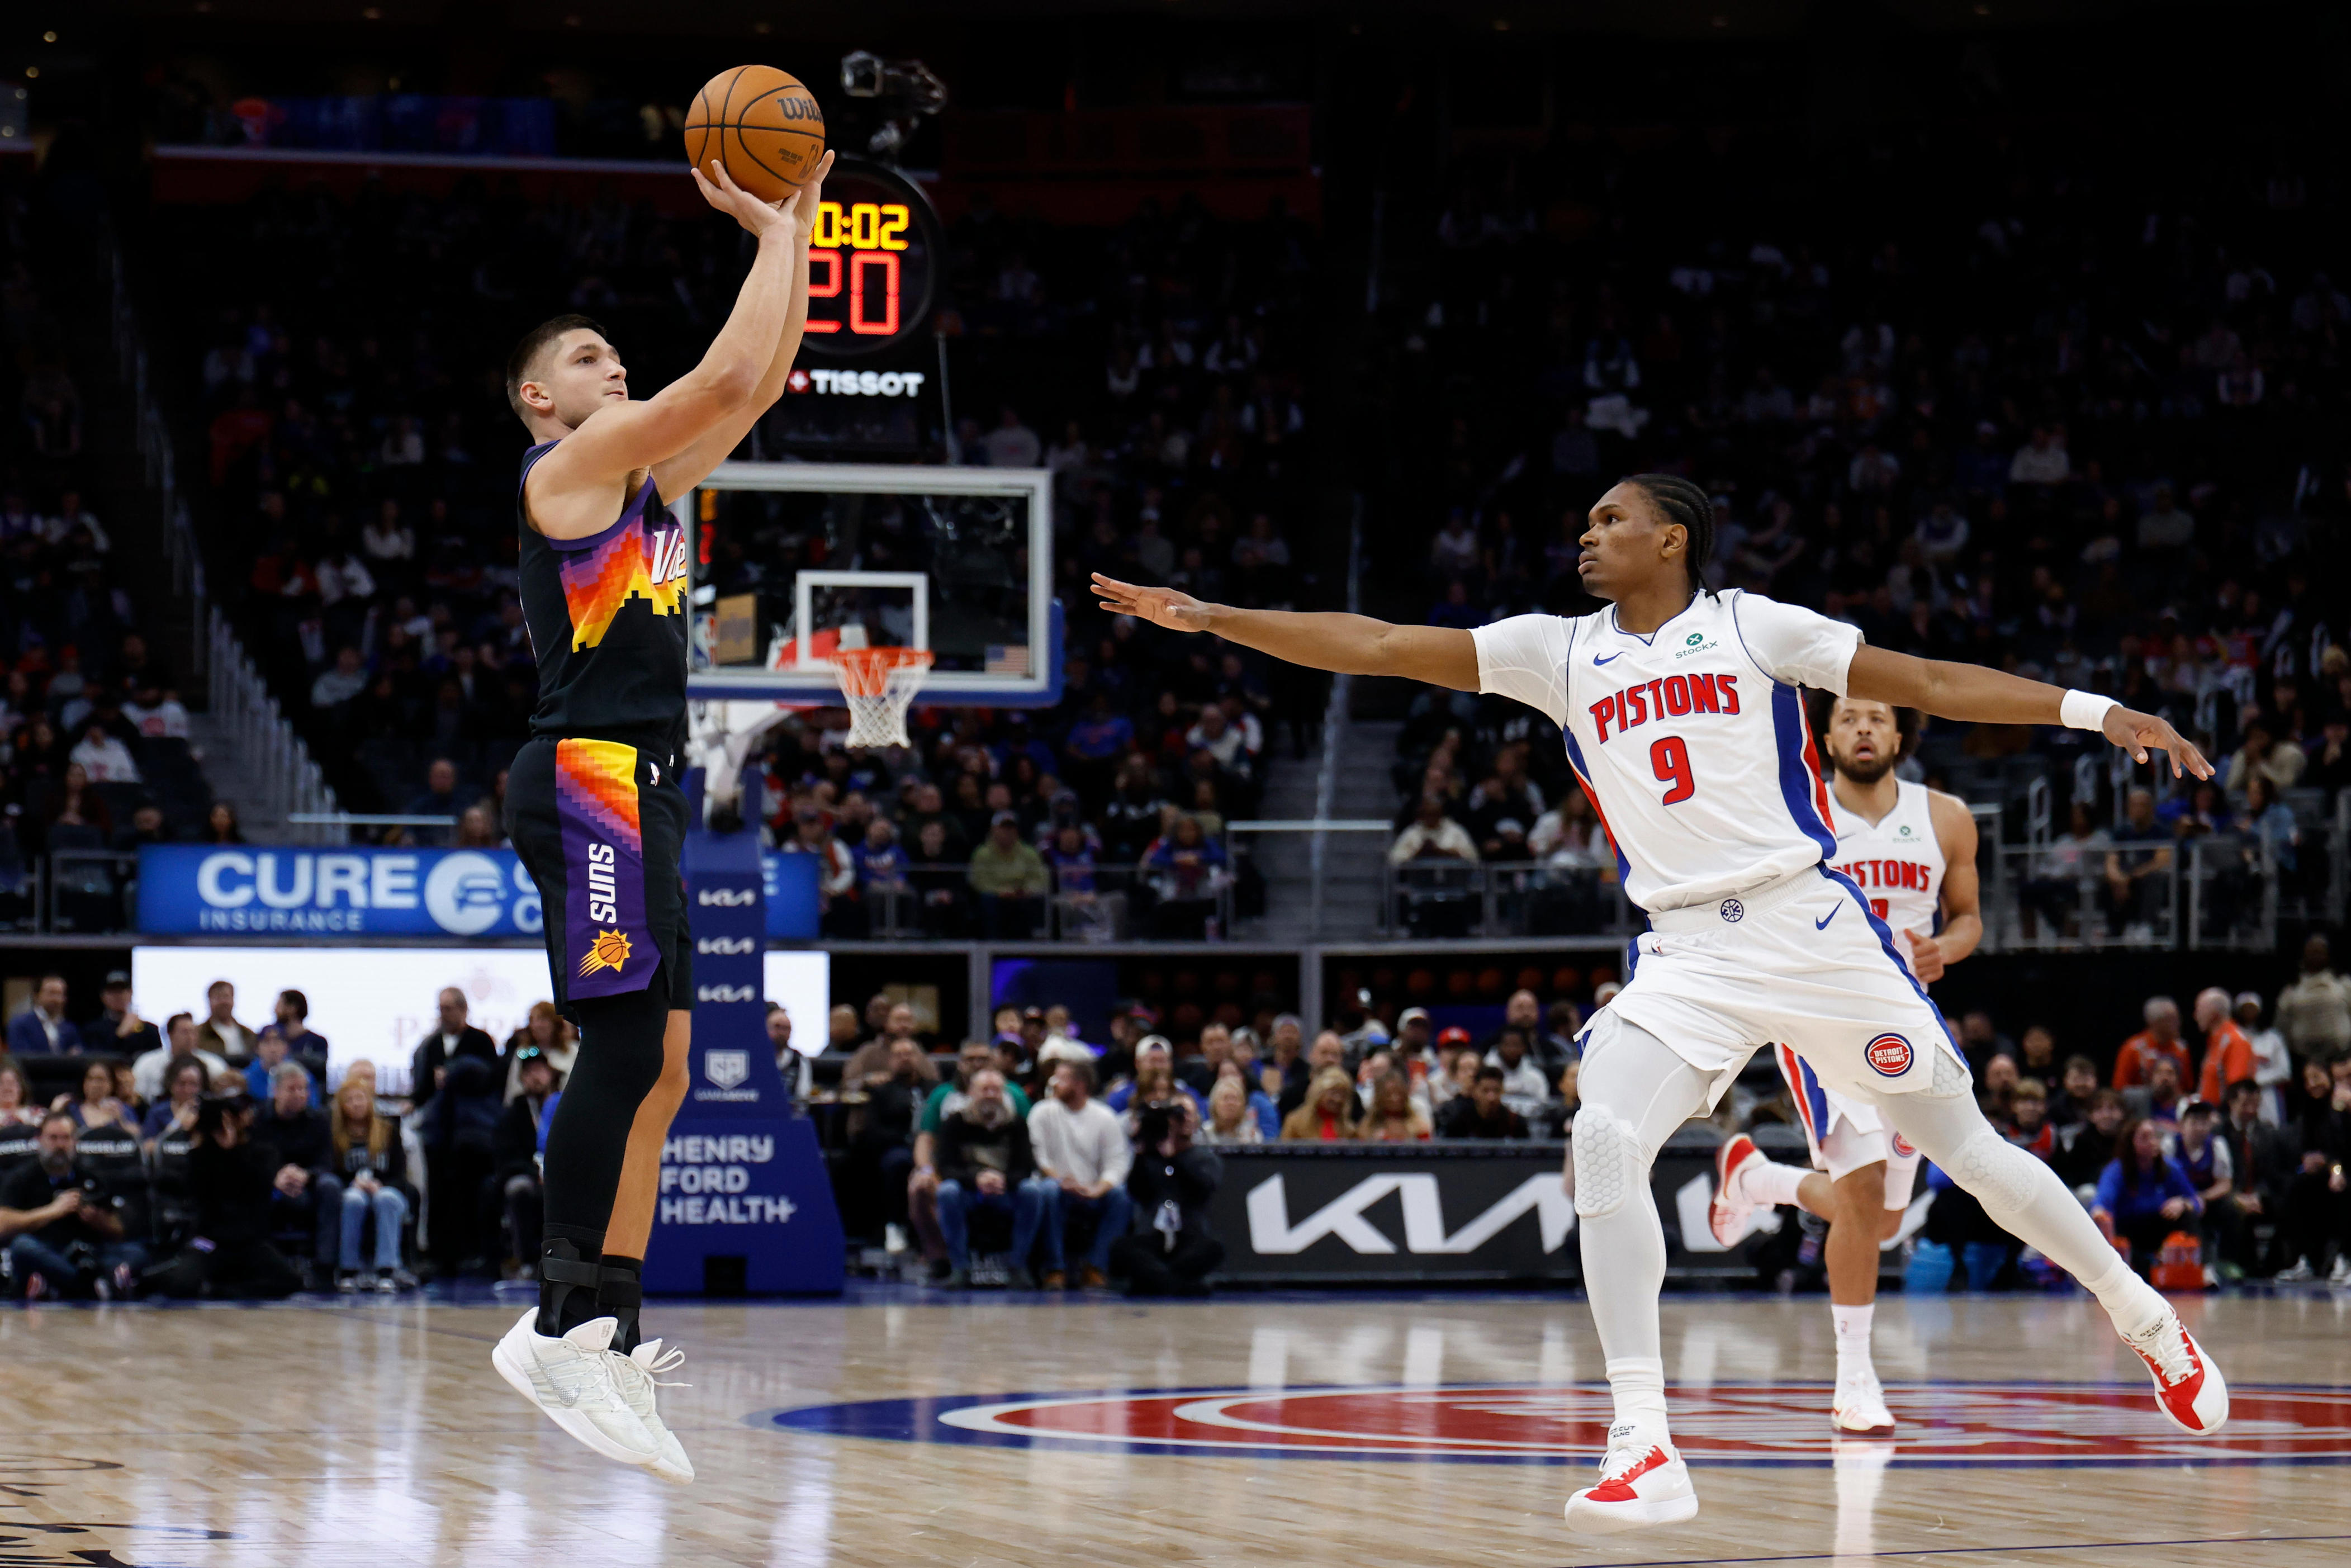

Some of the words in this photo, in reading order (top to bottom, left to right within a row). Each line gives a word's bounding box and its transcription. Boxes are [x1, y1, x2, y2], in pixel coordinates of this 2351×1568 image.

[809, 202, 909, 250] 0:02
[804, 249, 899, 335] 20
[809, 370, 925, 397] TISSOT
[1589, 673, 1739, 745] PISTONS
[1650, 736, 1695, 806] 9
[197, 852, 419, 908] CURE
[588, 843, 617, 924] SUNS
[1833, 860, 1931, 893] STONS
[200, 909, 364, 931] INSURANCE
[1874, 1046, 1903, 1057] DETROIT
[1875, 1054, 1905, 1064] PISTONS
[662, 1134, 775, 1163] HENRY
[660, 1165, 750, 1194] FORD
[1247, 1172, 1576, 1254] KIA
